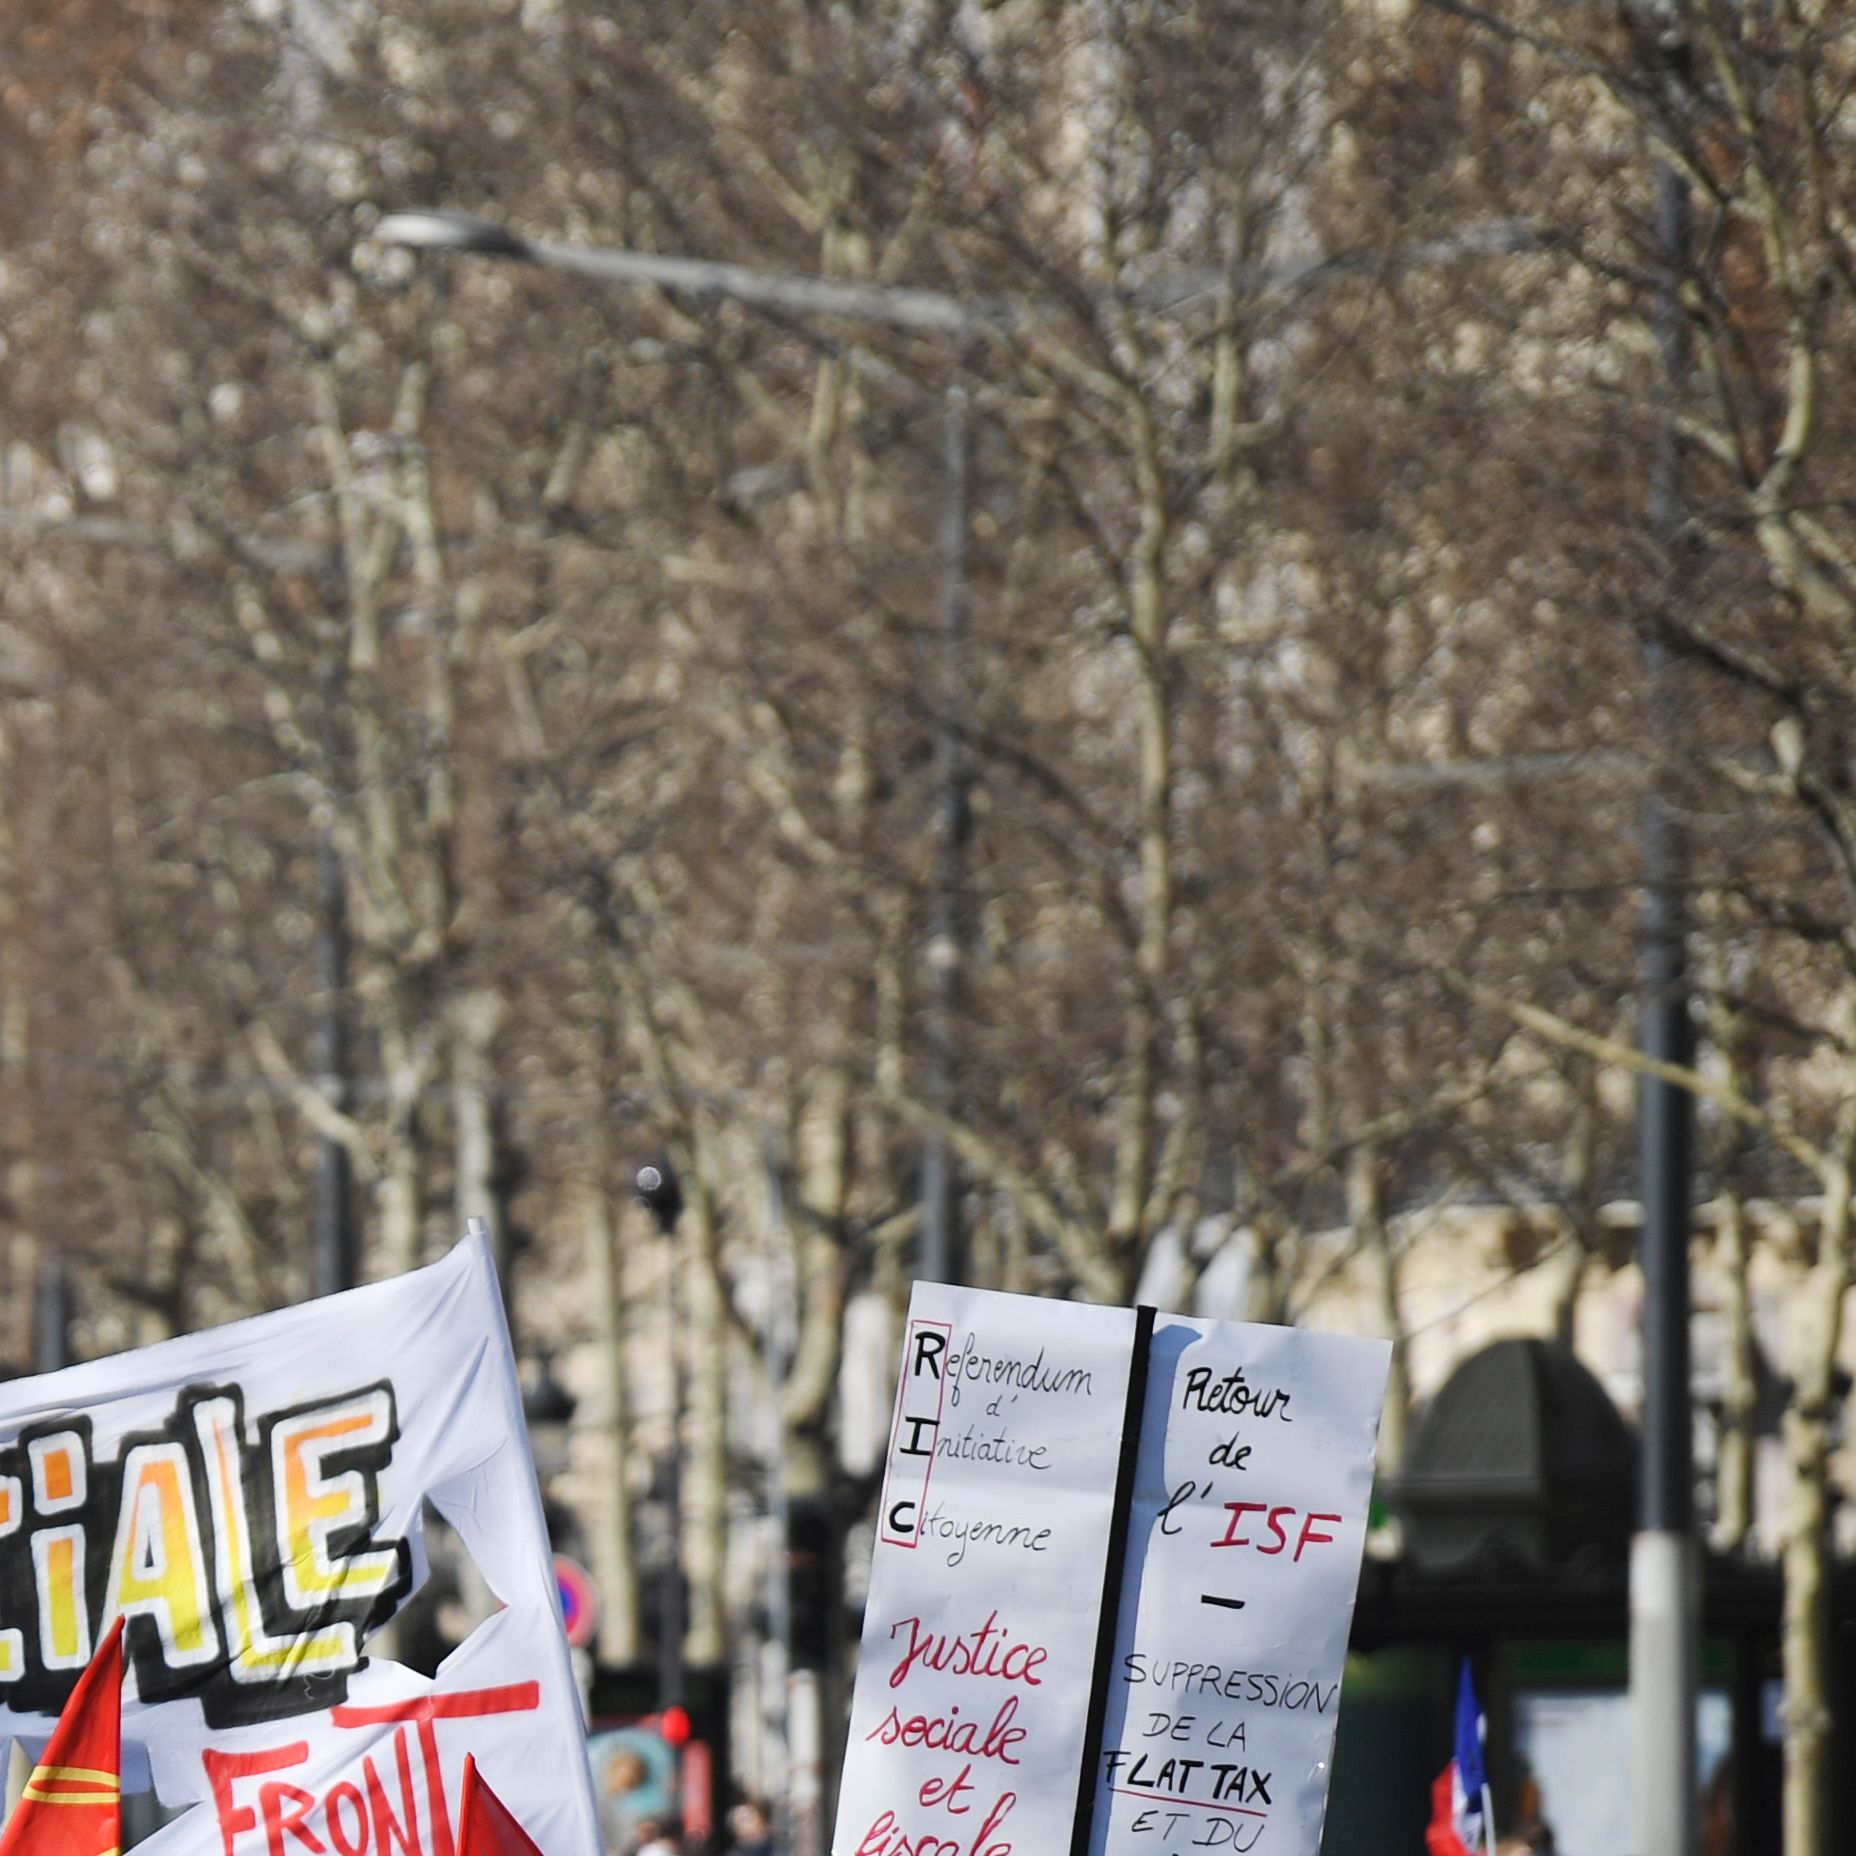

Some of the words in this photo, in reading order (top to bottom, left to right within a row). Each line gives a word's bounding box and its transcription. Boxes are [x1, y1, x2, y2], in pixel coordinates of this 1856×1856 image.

[1183, 1366, 1293, 1422] Retour
[899, 1415, 1051, 1470] Initiative
[1209, 1431, 1252, 1471] de
[888, 1499, 1052, 1567] Citoyenne
[1209, 1502, 1343, 1563] ISF
[889, 1610, 1048, 1689] Justice
[865, 1695, 1027, 1765] sociale
[1142, 1712, 1196, 1741] DE
[1206, 1720, 1246, 1752] LA
[919, 1763, 975, 1814] et
[1103, 1750, 1204, 1793] FLAT
[1211, 1764, 1273, 1805] TAX
[1131, 1810, 1191, 1840] ET
[1192, 1817, 1264, 1853] DU
